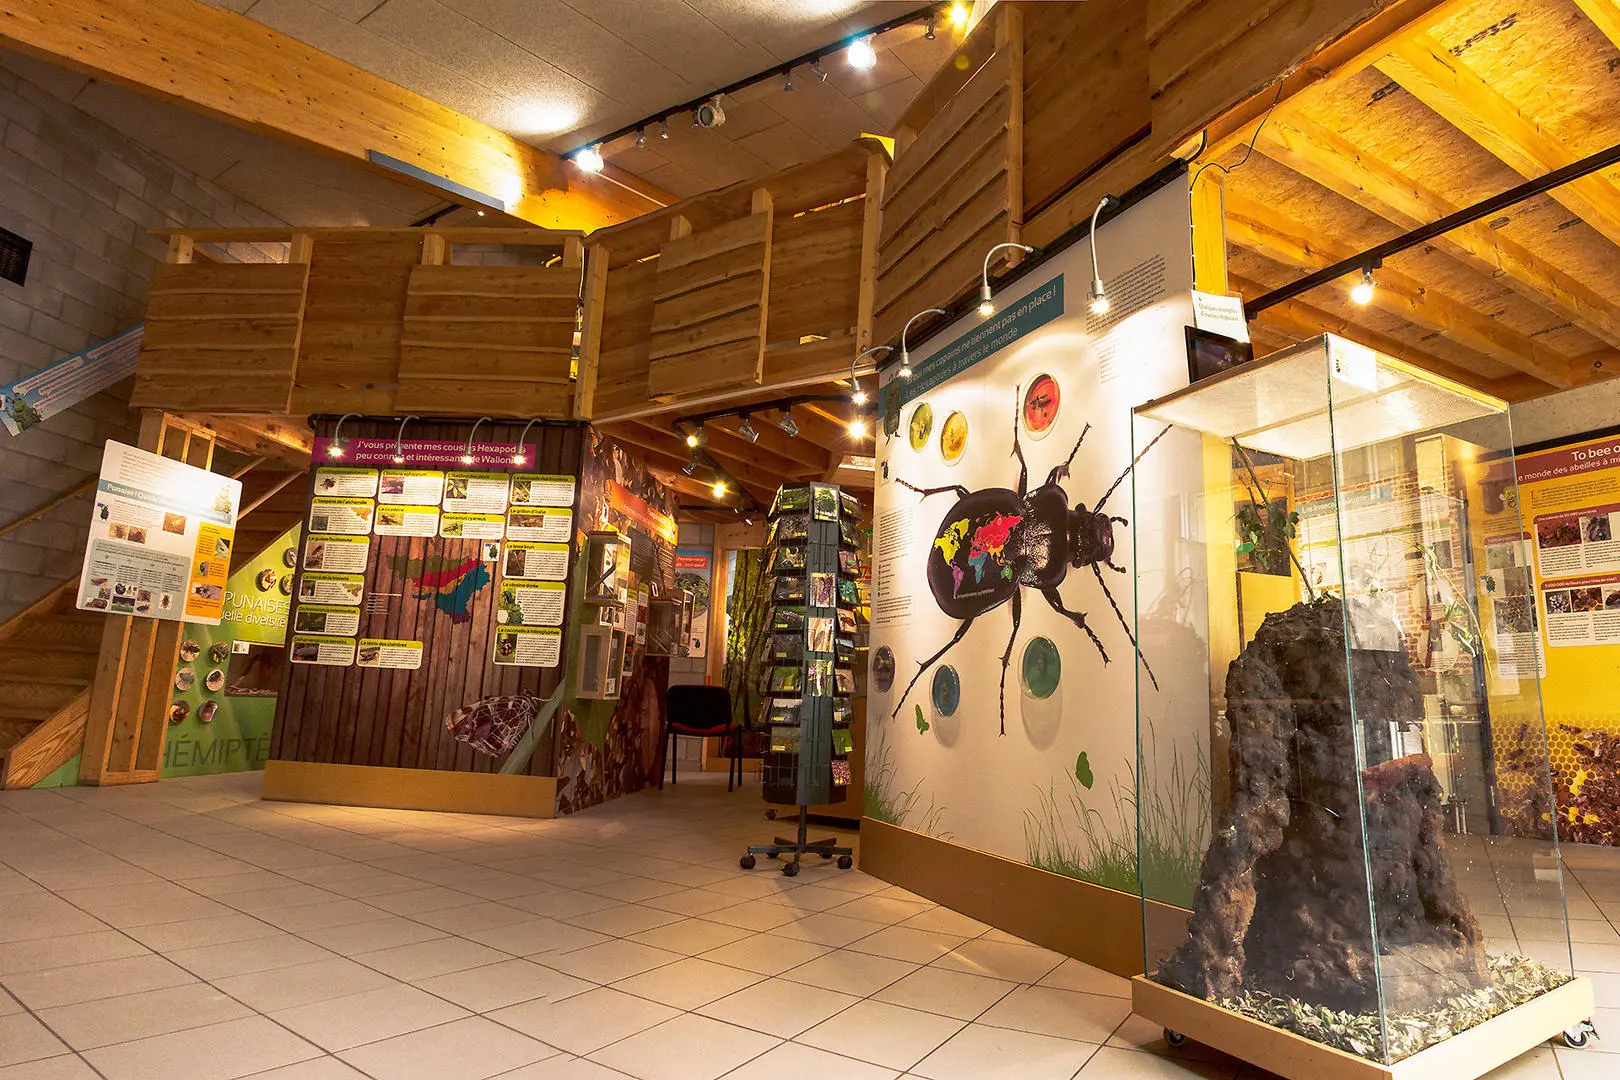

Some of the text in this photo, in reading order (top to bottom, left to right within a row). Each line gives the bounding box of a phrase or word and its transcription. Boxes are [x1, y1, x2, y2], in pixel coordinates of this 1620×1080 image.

[1002, 312, 1017, 330] pas
[1017, 304, 1028, 317] en
[1028, 290, 1052, 313] place
[990, 328, 1018, 350] monde
[357, 440, 384, 449] J'vous
[423, 443, 442, 451] mes
[443, 444, 476, 452] cousis
[477, 444, 526, 454] Hexapods
[1571, 451, 1587, 461] To
[1588, 446, 1611, 458] bee
[355, 452, 373, 461] peu
[373, 453, 404, 461] conns
[406, 453, 415, 461] et
[415, 452, 467, 463] intéressan
[481, 455, 518, 464] Wallon
[1524, 469, 1552, 480] monde
[1552, 466, 1568, 475] des
[1569, 460, 1601, 472] abeilles
[1602, 457, 1609, 465] à
[107, 483, 133, 497] Punaise
[222, 591, 291, 616] PUNAISES
[245, 612, 287, 628] diversité
